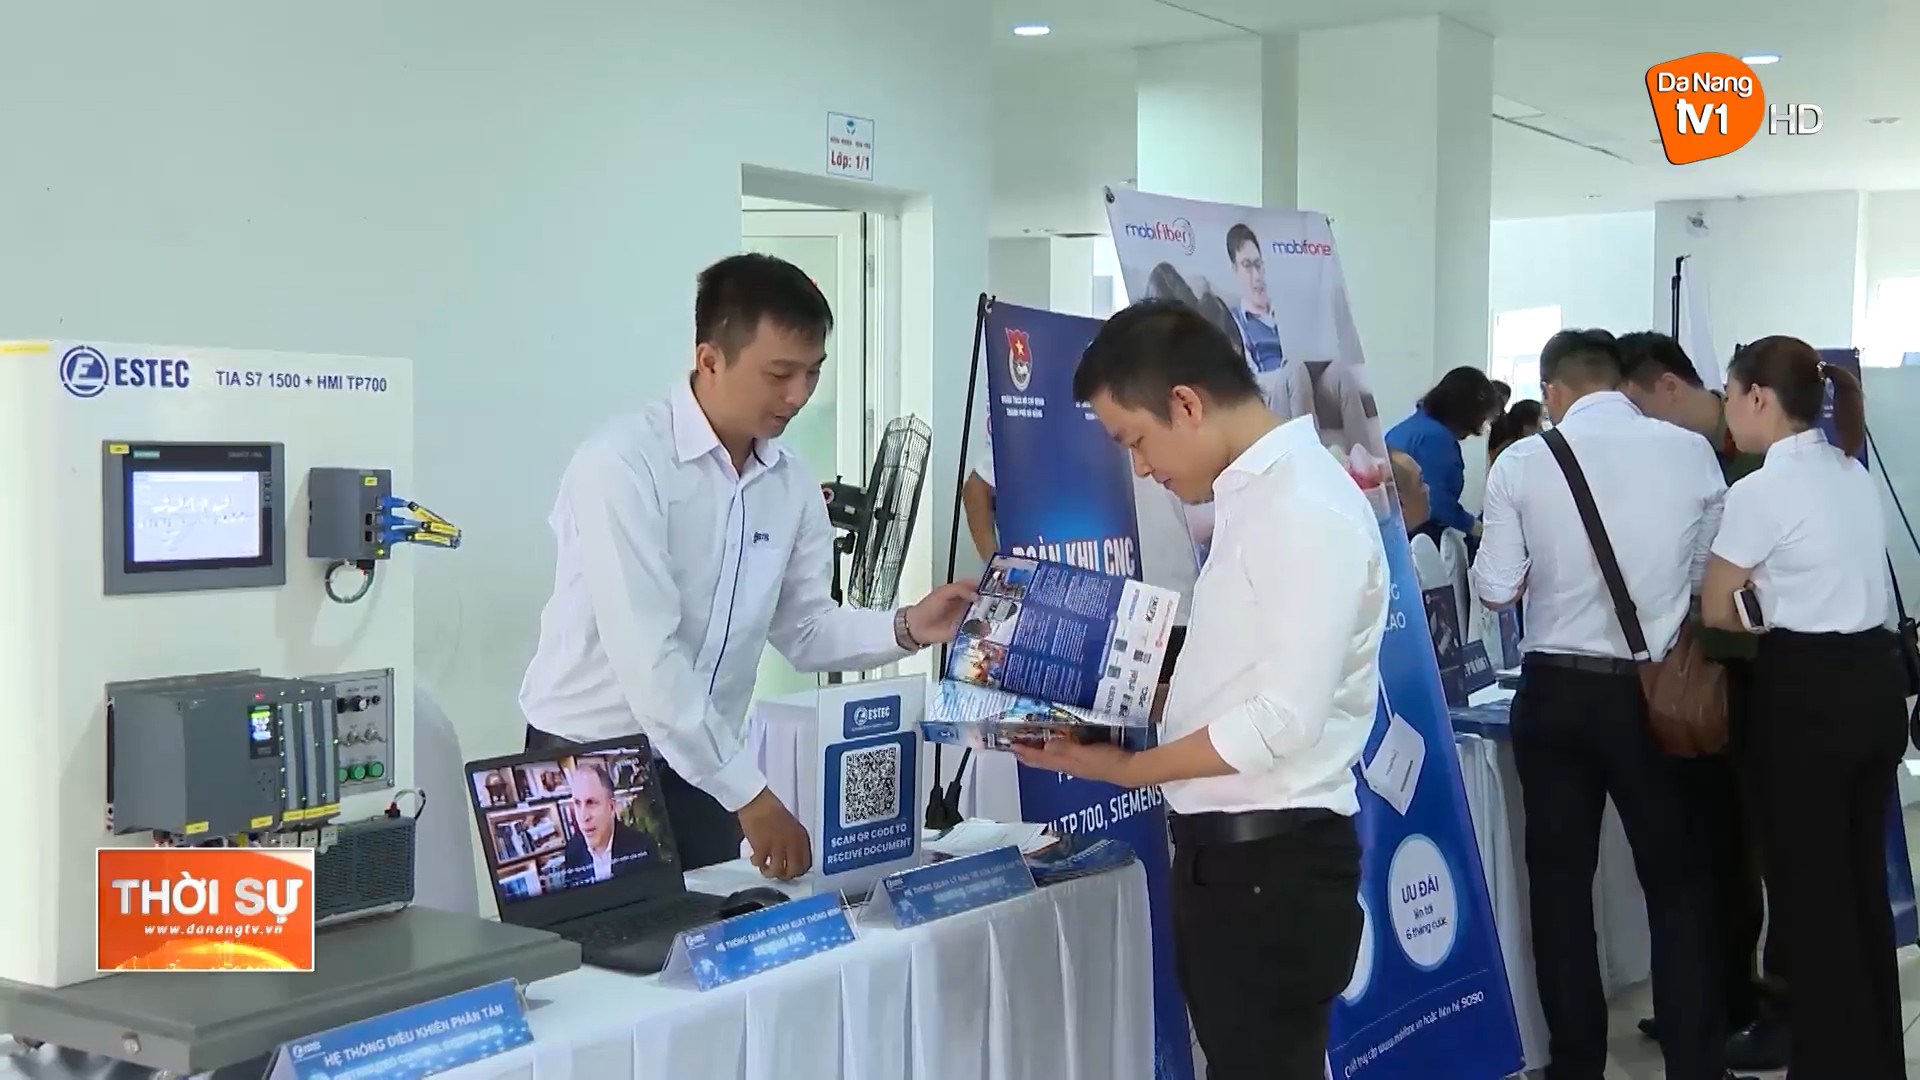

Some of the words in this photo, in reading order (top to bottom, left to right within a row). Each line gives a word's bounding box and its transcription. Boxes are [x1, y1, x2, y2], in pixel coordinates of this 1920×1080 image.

[856, 155, 870, 171] 1/1
[1272, 239, 1332, 256] mobifone
[114, 357, 190, 388] ESTEC
[216, 371, 241, 386] TIA
[245, 371, 263, 386] S7
[269, 372, 301, 388] 1500
[305, 376, 313, 386] +
[317, 374, 342, 390] HMI
[346, 376, 387, 392] TP700
[1103, 537, 1135, 576] CNC
[1110, 784, 1162, 824] SIEMENS
[831, 833, 856, 848] SCAN
[870, 825, 894, 838] CODE
[895, 823, 907, 834] TO
[827, 847, 863, 864] RECEIVE
[863, 837, 912, 856] DOCUMENT
